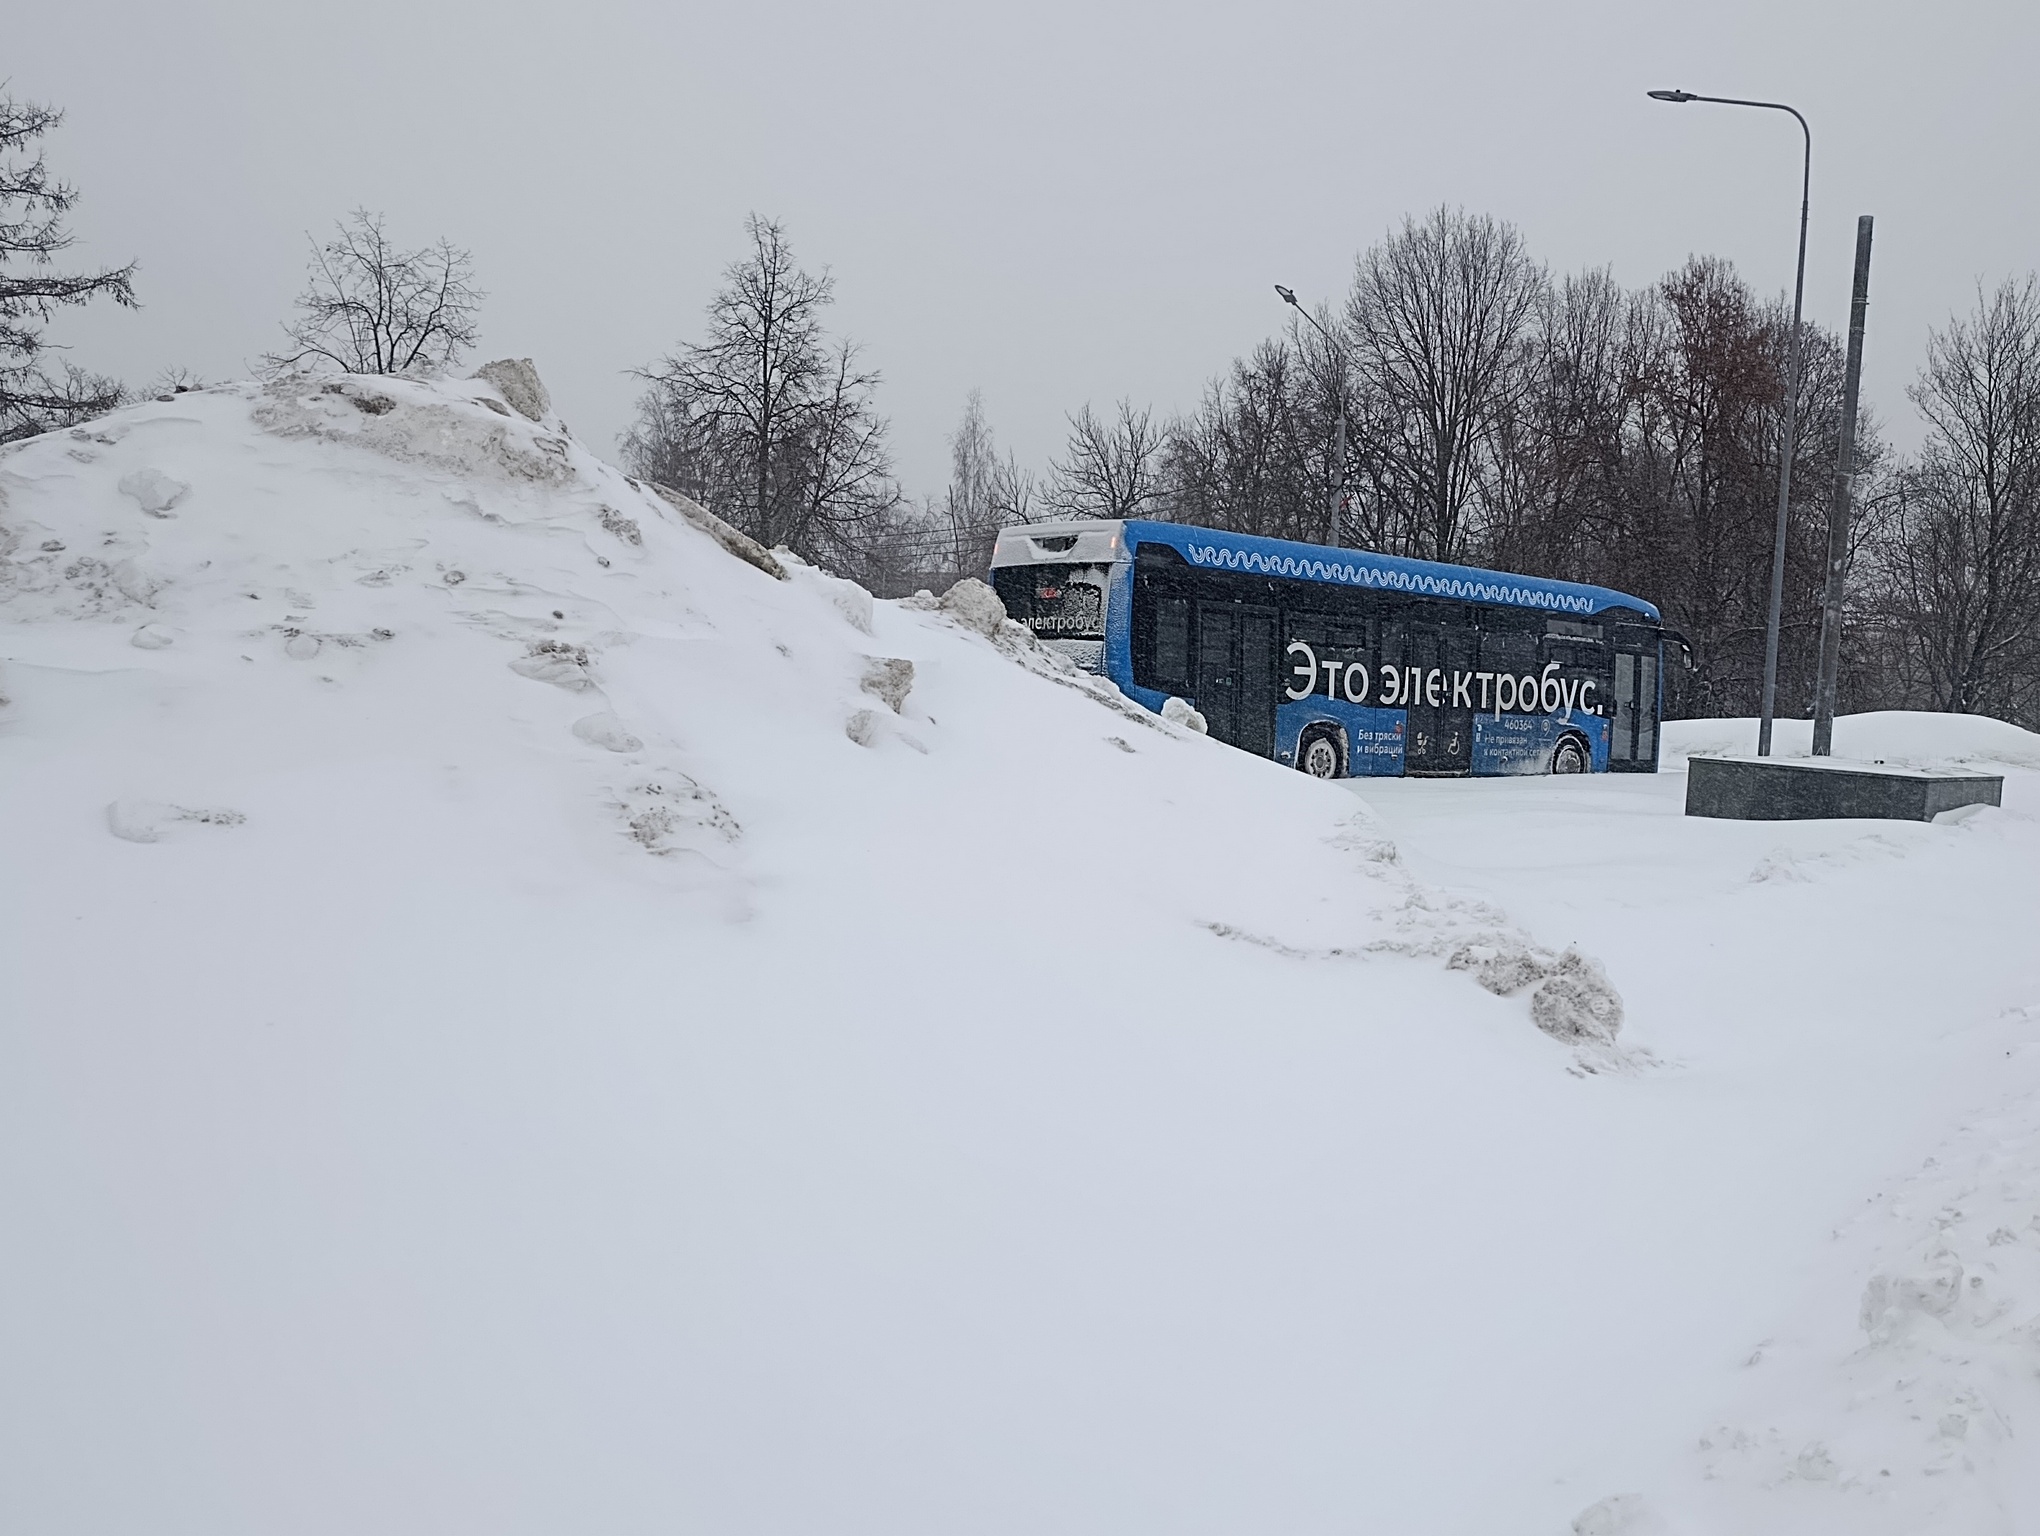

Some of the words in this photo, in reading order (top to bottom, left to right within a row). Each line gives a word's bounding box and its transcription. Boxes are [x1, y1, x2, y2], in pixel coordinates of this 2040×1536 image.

[1285, 642, 1369, 703] Это
[1379, 663, 1603, 725] электробус.
[1504, 719, 1533, 731] 460364
[1358, 728, 1373, 741] Без
[1375, 732, 1401, 742] тряски
[1484, 732, 1495, 744] Не
[1495, 735, 1528, 745] привязан
[1357, 745, 1363, 754] и
[1364, 743, 1403, 756] вибраций
[1489, 746, 1528, 757] контактной
